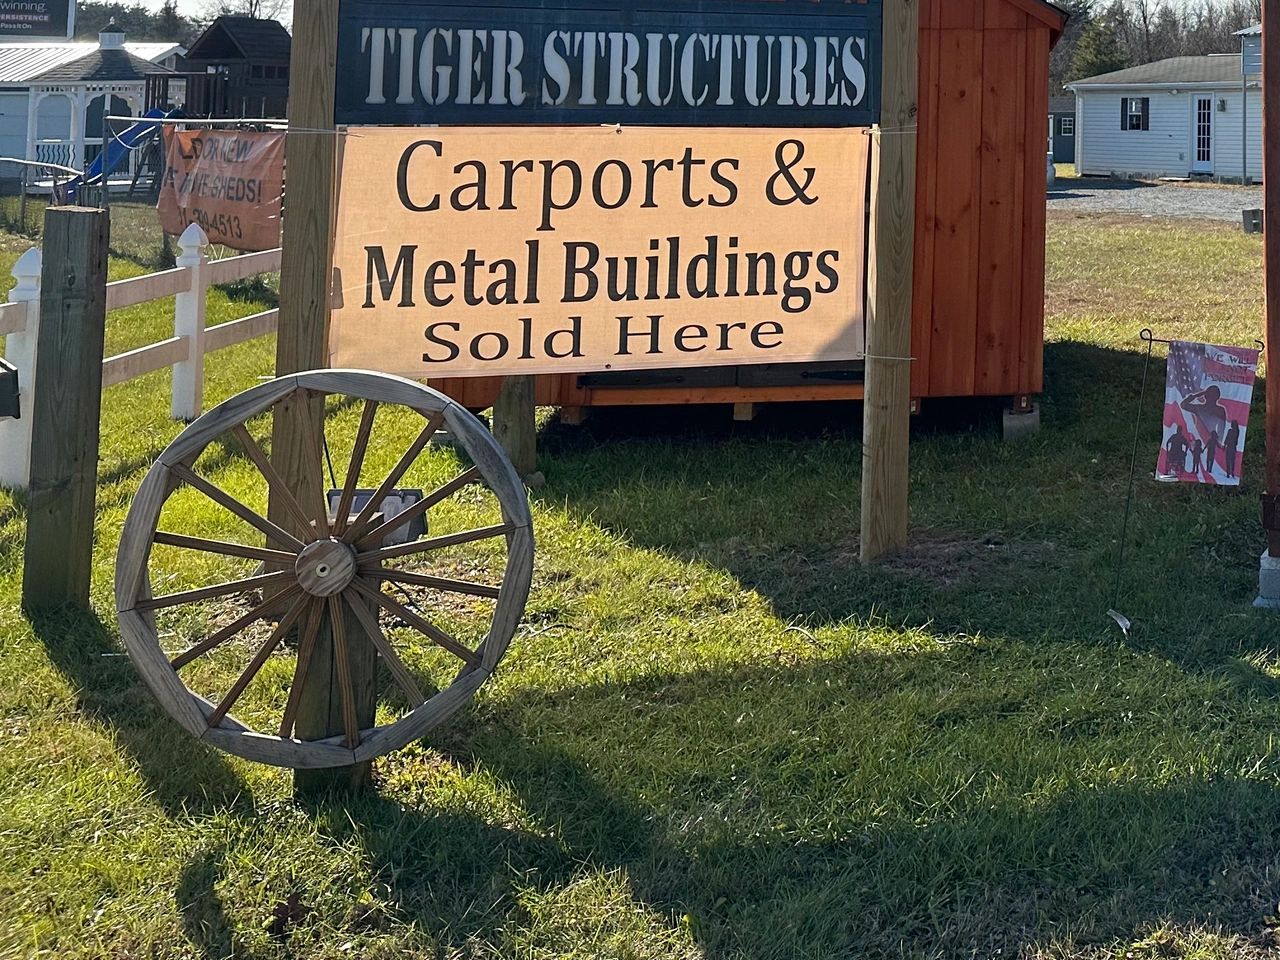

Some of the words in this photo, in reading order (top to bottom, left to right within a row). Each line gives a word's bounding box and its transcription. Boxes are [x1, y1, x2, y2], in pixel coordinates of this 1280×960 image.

[361, 26, 528, 106] TIGER
[541, 29, 867, 107] STRUCTURES
[396, 139, 739, 232] Carports
[765, 138, 819, 207] &
[361, 240, 540, 309] Metal
[560, 235, 840, 314] Buildings
[422, 316, 586, 364] Sold
[614, 313, 784, 357] Here
